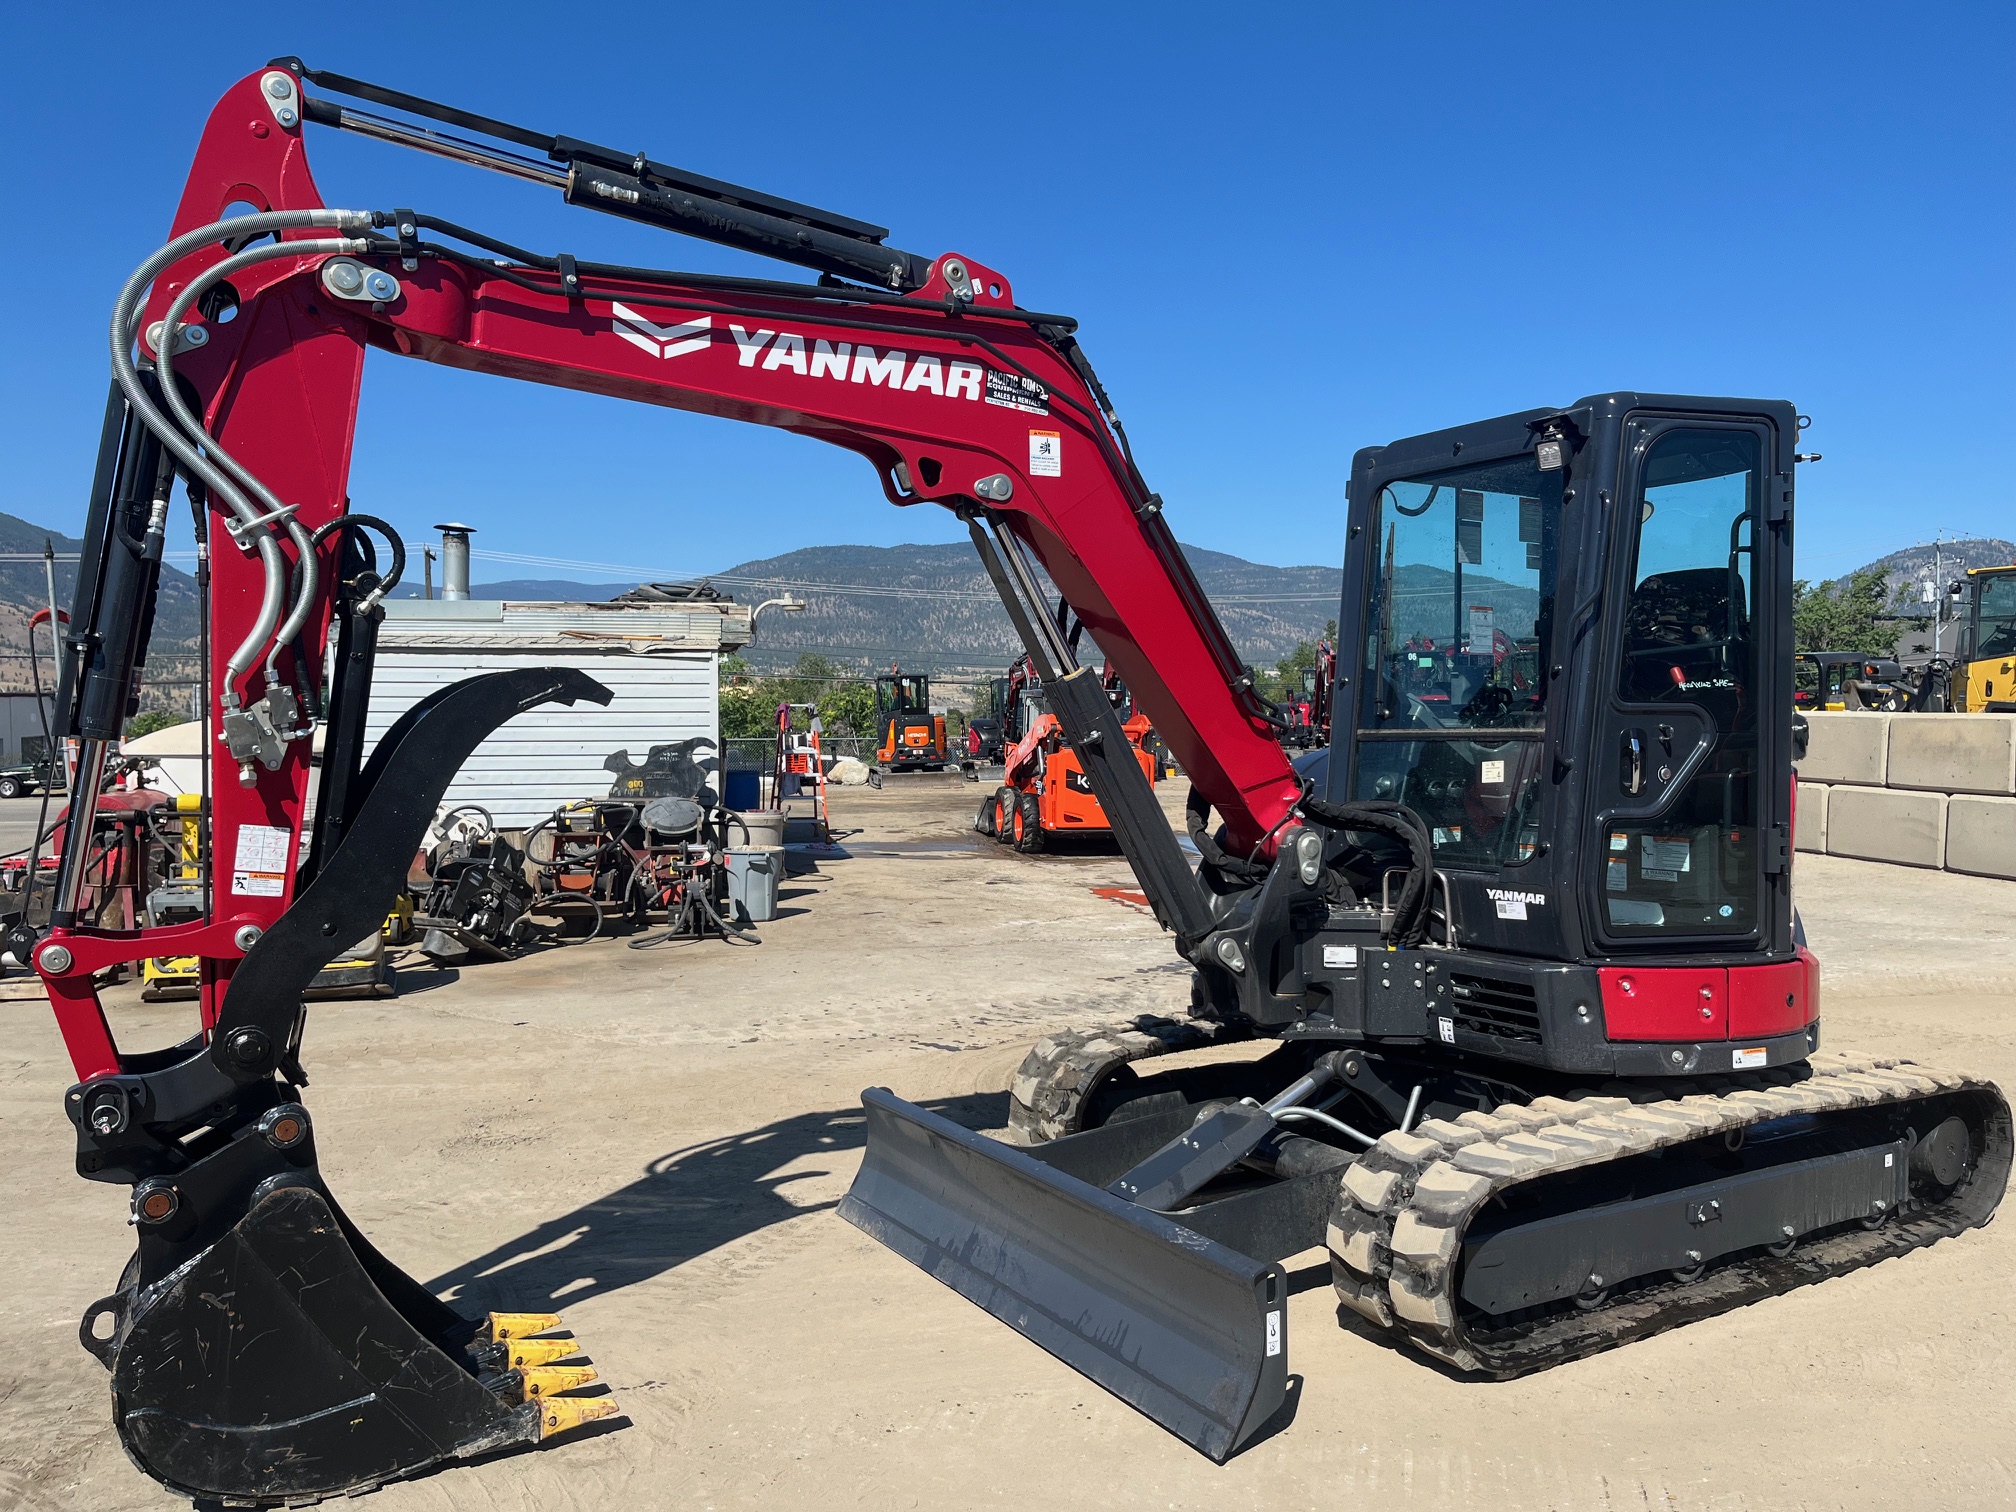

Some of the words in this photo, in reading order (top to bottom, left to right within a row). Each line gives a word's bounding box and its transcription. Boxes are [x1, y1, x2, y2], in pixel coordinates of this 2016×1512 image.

[728, 323, 983, 402] YANMAR
[987, 369, 1019, 389] PACIFIC
[986, 381, 1034, 398] EQUIPMENT
[993, 391, 1010, 401] SALES
[1017, 396, 1042, 407] RENTALS
[1407, 652, 1417, 661] 06
[1485, 888, 1546, 905] YANMAR
